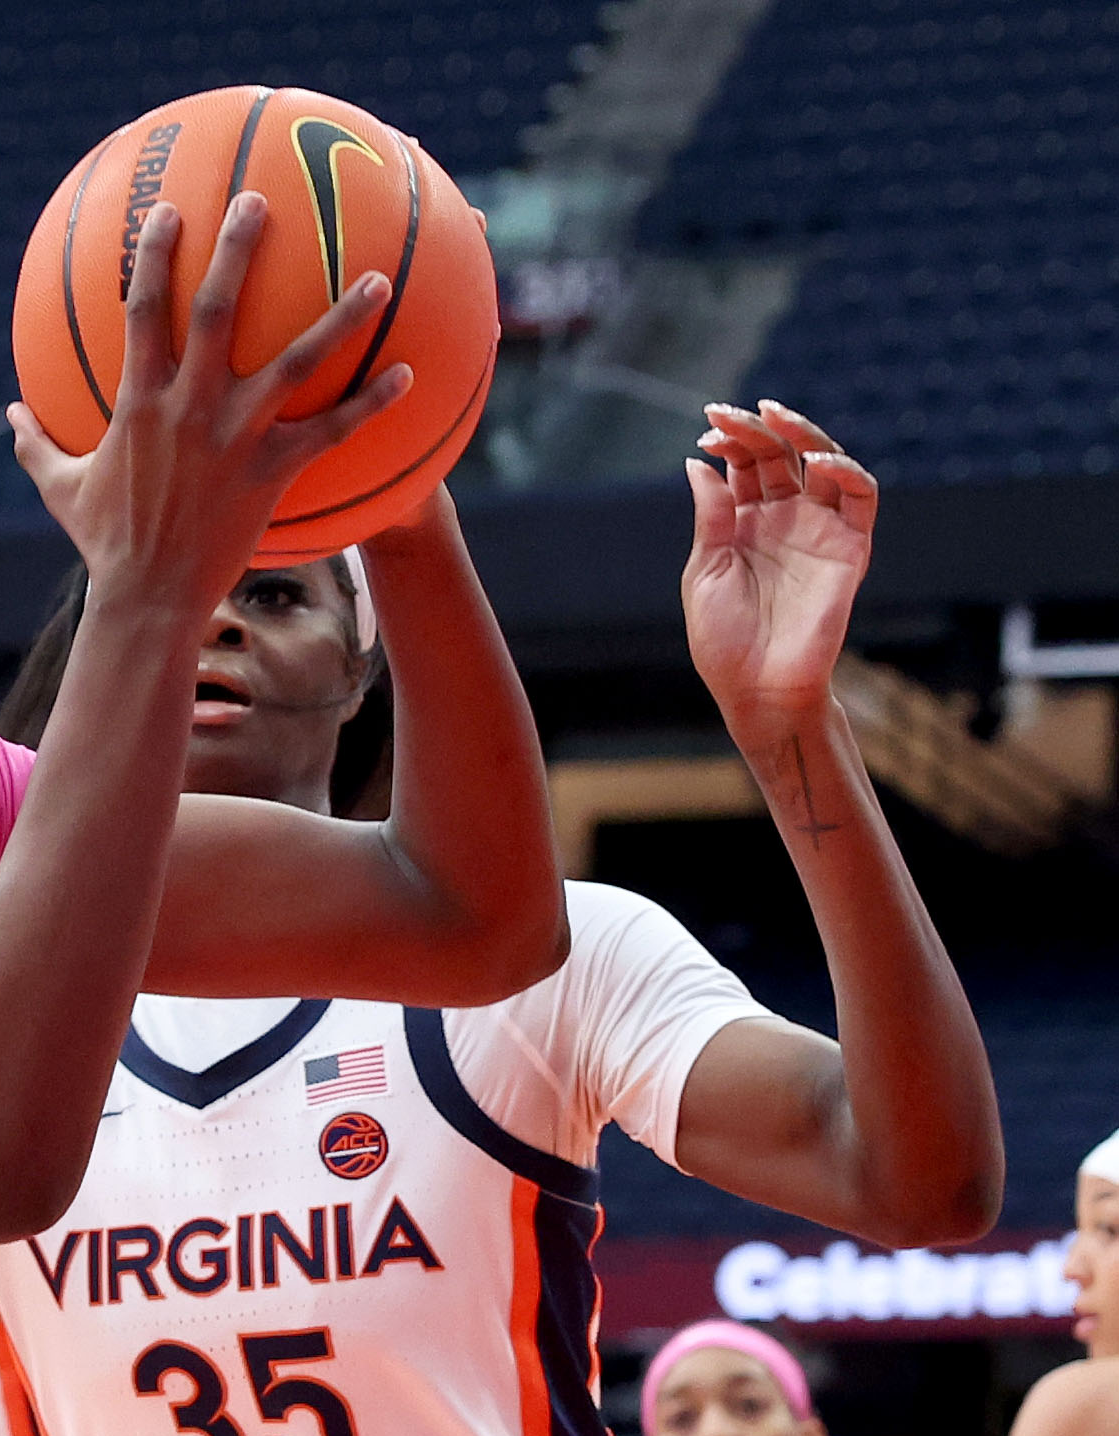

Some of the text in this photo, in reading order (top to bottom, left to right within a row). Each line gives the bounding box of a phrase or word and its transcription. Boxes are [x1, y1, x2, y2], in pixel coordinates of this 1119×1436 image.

[120, 122, 183, 302] SYRACU
[329, 1130, 381, 1151] ACC
[27, 1195, 445, 1311] VIRGINIA
[714, 1232, 1079, 1322] Celebrat
